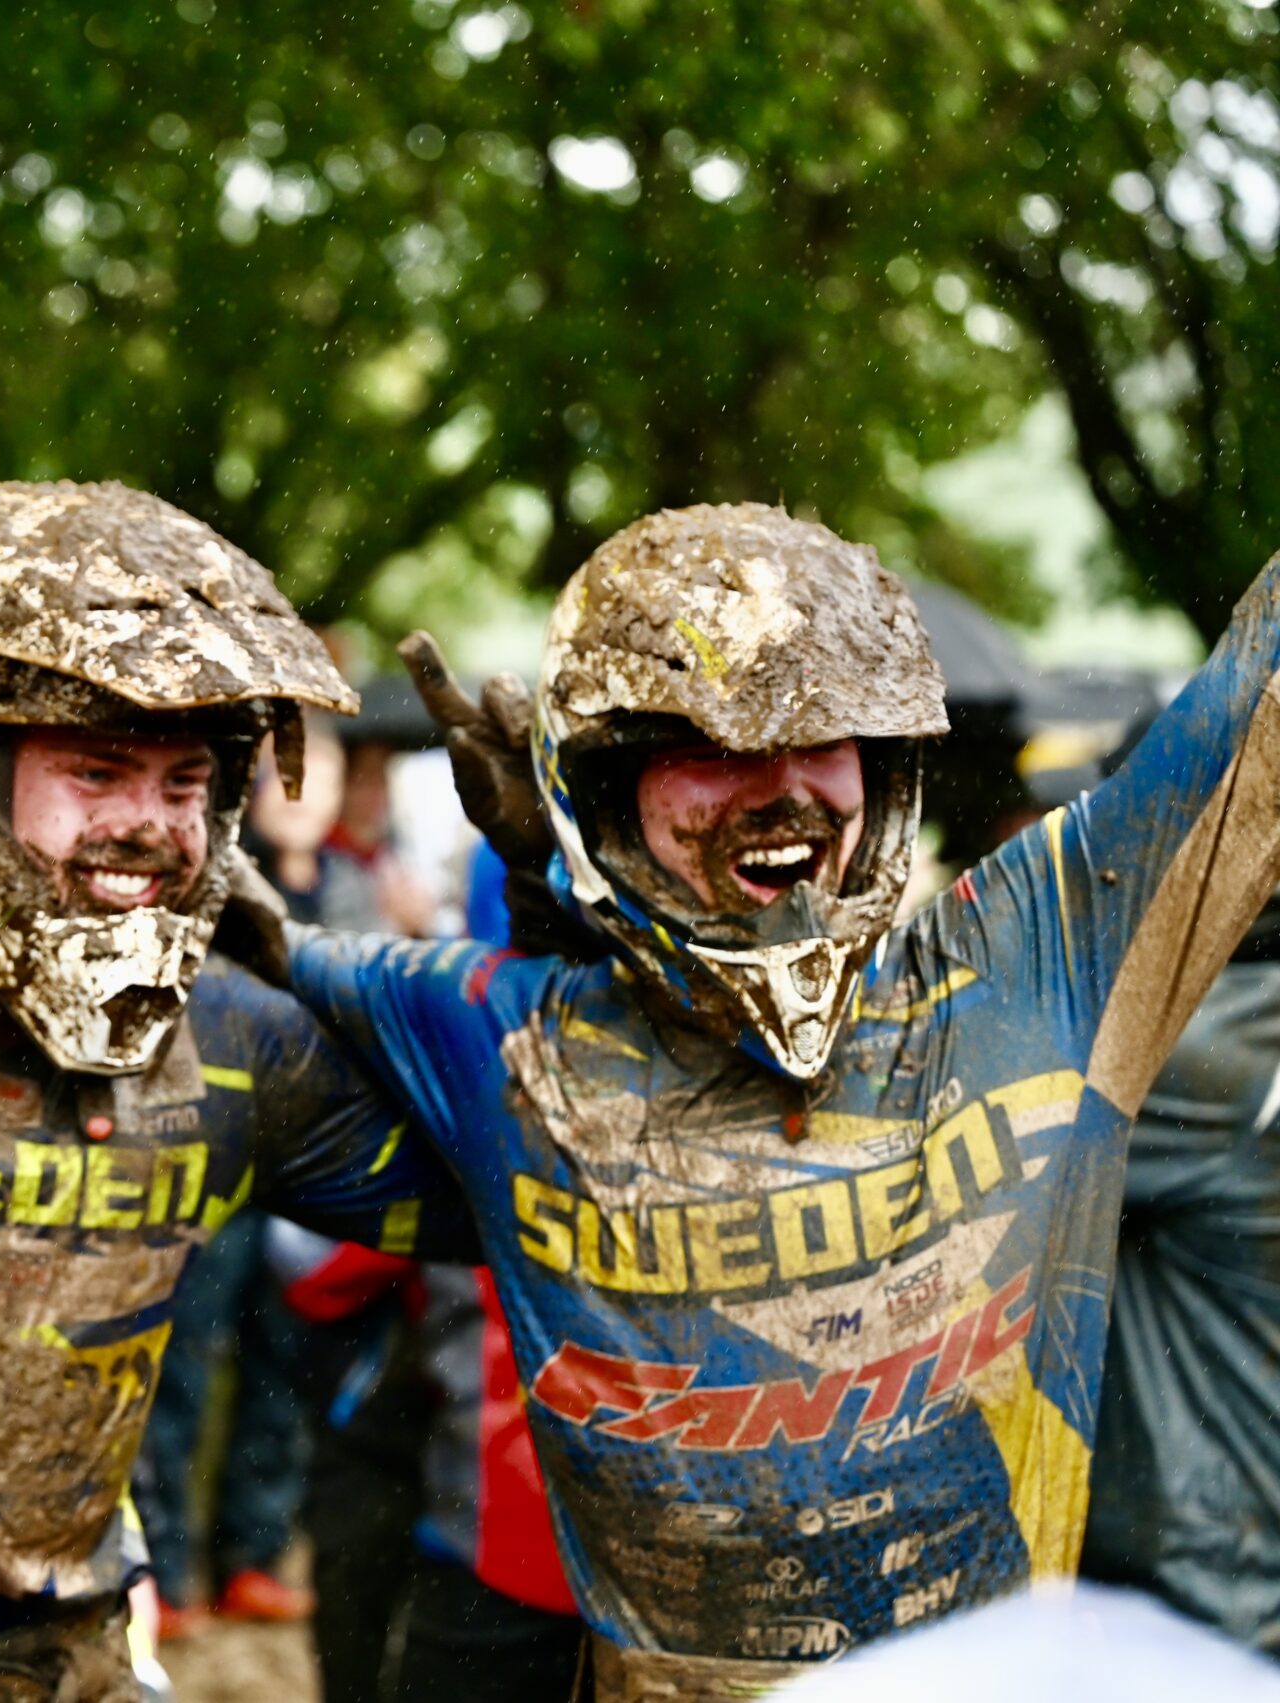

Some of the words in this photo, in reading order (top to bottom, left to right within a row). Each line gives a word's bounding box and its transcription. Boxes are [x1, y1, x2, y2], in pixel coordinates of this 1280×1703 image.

[513, 1100, 1005, 1296] SWEDEN
[531, 1265, 1037, 1452] FANTIC
[806, 1308, 863, 1346] FIM
[827, 1487, 895, 1531] SDI
